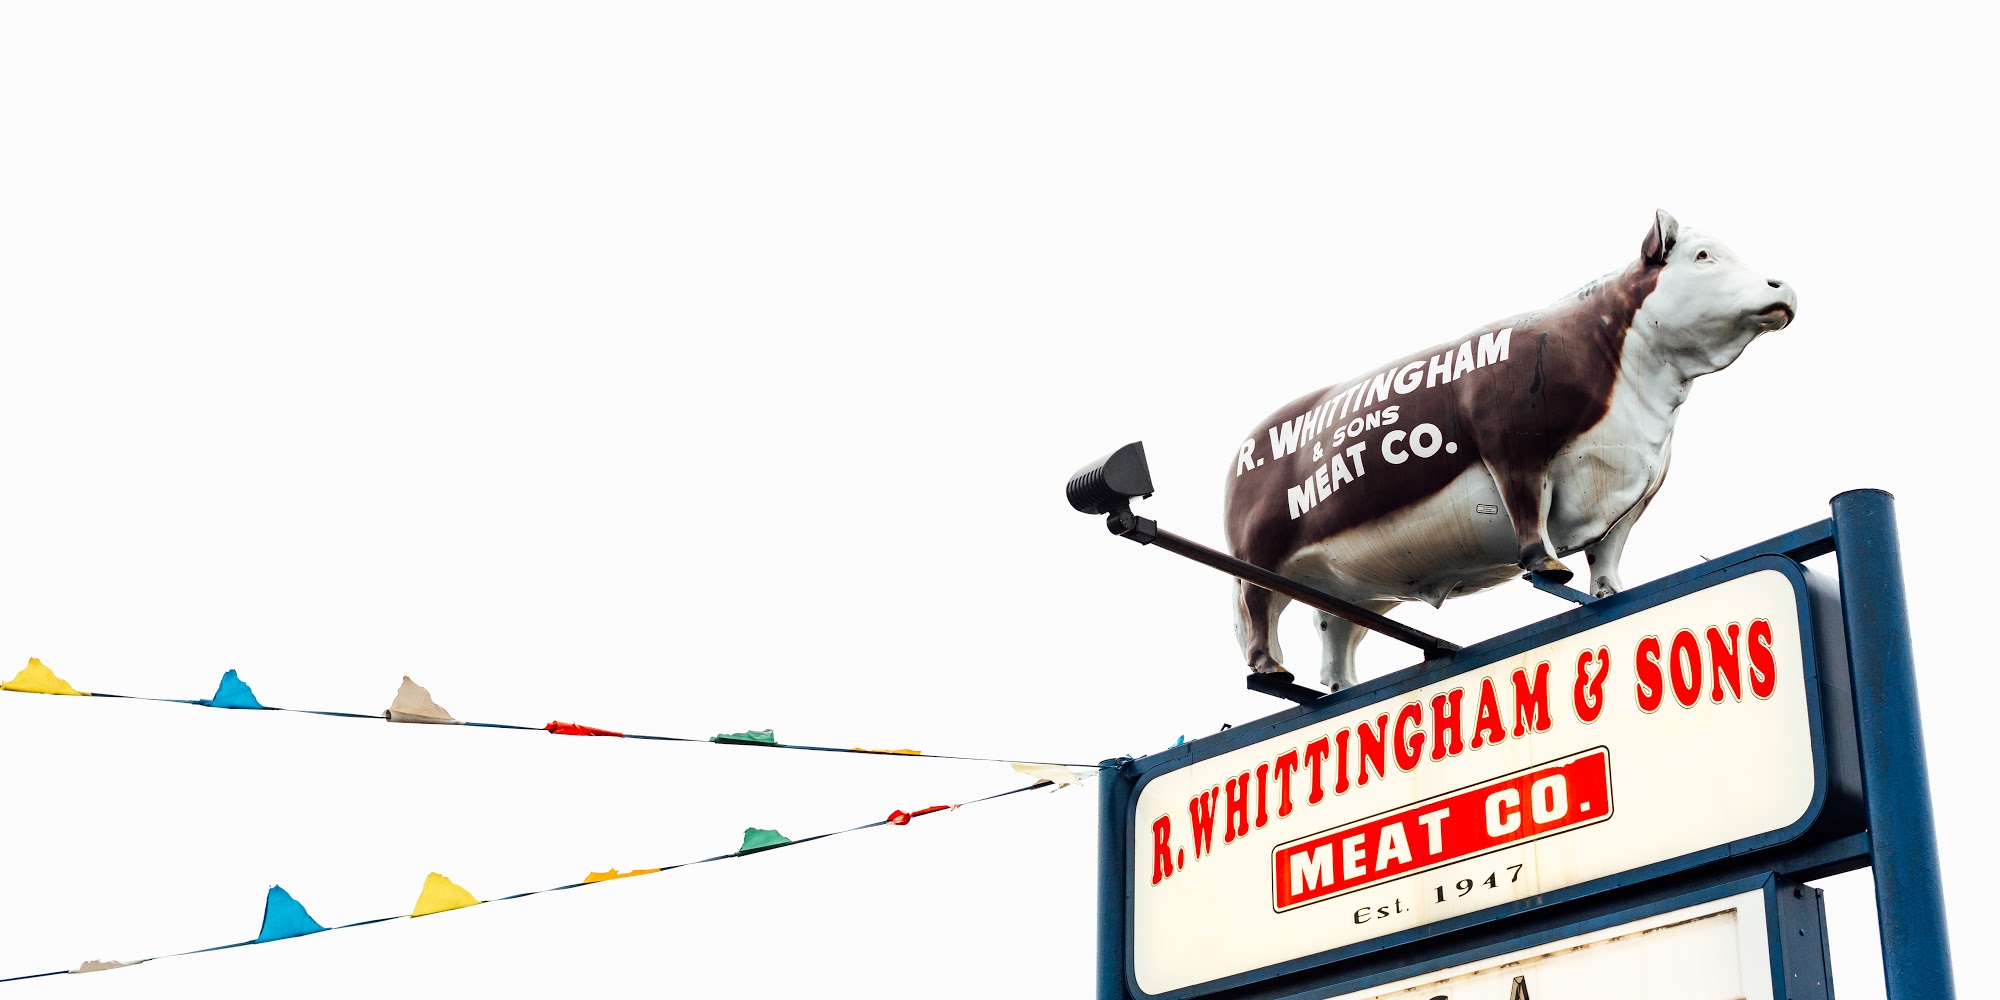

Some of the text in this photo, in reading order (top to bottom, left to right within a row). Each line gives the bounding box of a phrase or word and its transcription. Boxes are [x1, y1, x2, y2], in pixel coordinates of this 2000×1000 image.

[1236, 327, 1513, 477] R. WHITTINGHAM
[1312, 405, 1400, 462] & SONS
[1287, 422, 1458, 521] MEAT CO.
[1572, 645, 1612, 725] &
[1634, 617, 1778, 714] SONS
[1290, 773, 1591, 897] MEAT CO.
[1353, 863, 1523, 925] Est. 1947
